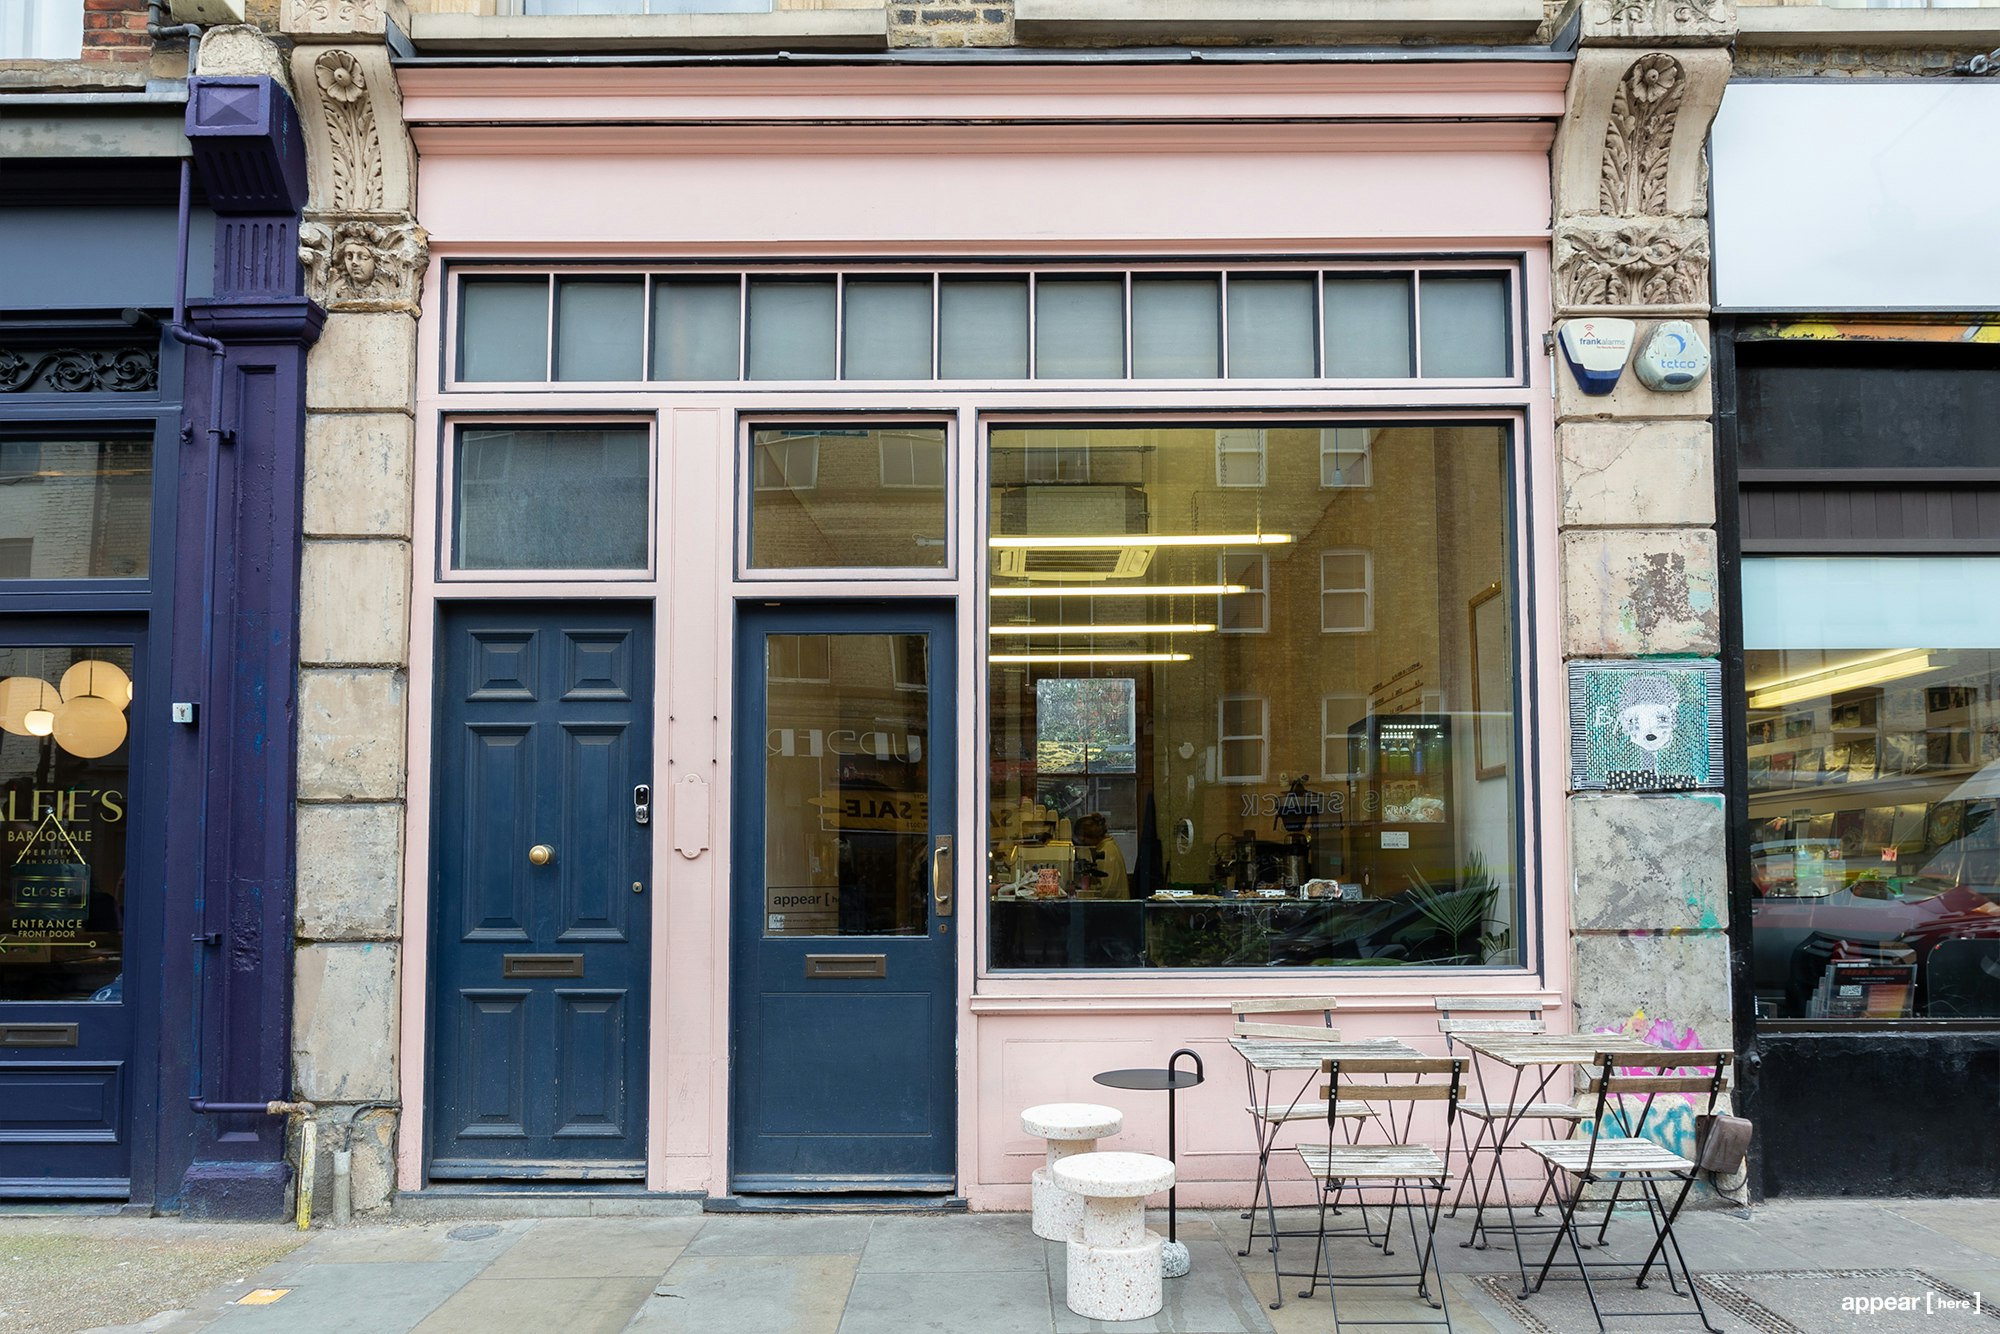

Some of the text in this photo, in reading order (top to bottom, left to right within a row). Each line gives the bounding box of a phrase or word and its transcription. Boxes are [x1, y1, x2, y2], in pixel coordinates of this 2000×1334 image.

[7, 830, 92, 842] BAR LOCALE
[21, 886, 76, 898] CLOSED
[773, 895, 822, 907] appear
[11, 919, 83, 929] ENTRANCE
[18, 930, 76, 938] FRONT DOOR
